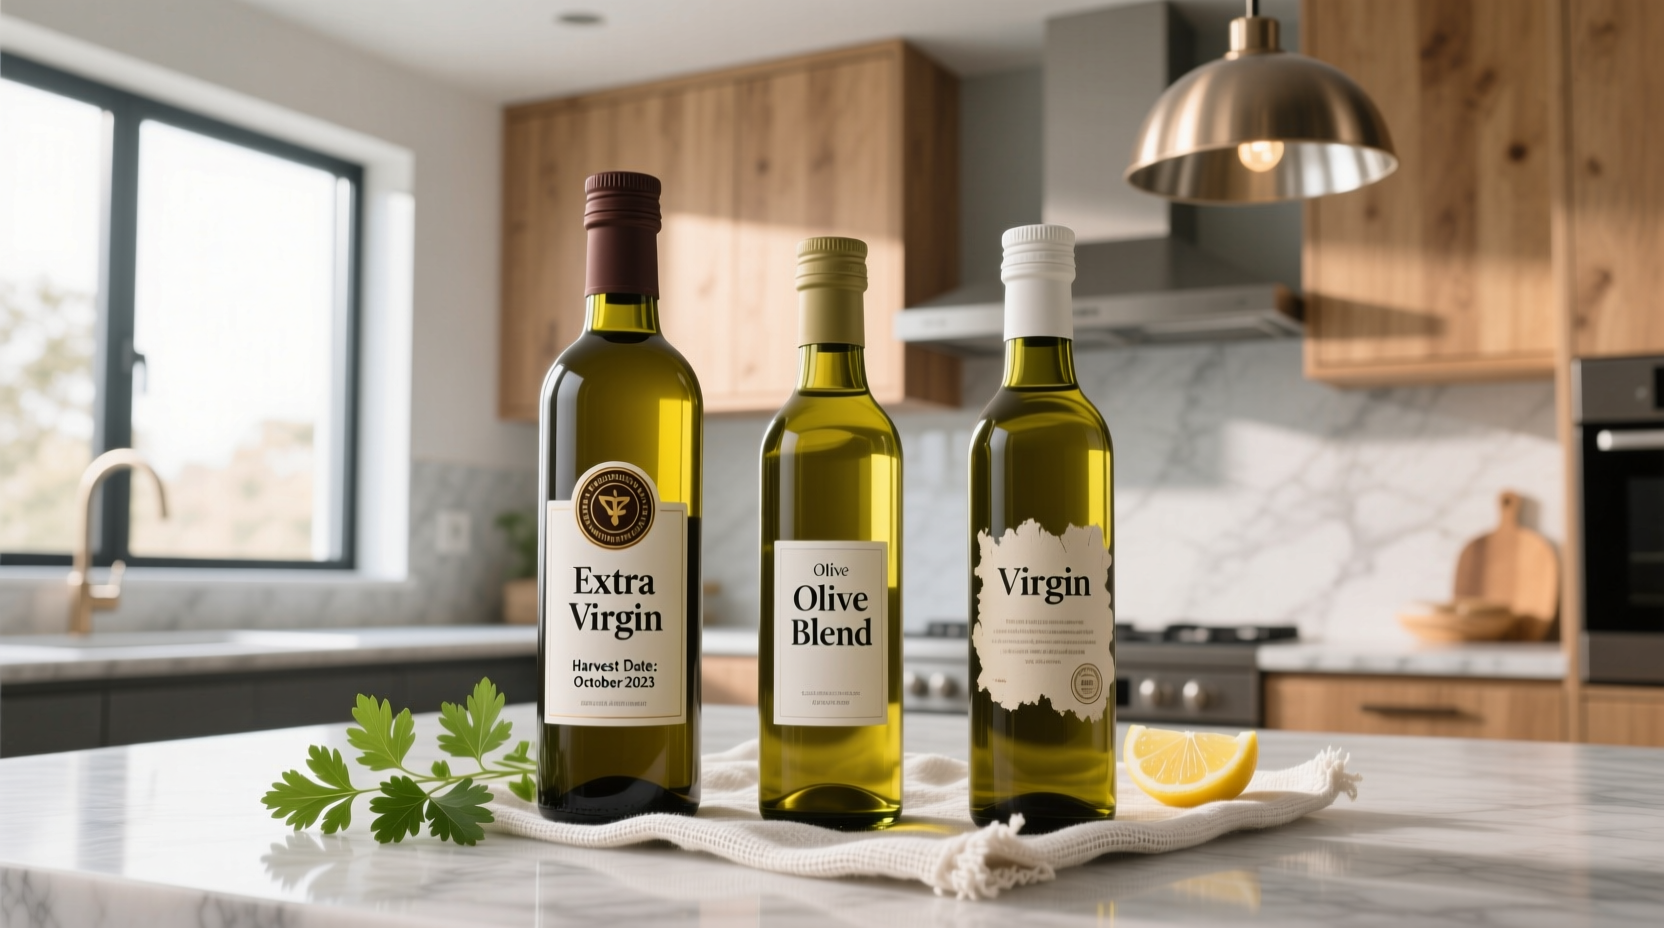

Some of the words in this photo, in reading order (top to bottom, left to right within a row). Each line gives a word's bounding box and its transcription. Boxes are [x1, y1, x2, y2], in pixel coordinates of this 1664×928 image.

[573, 566, 655, 595] Extra
[813, 562, 849, 577] Olive
[793, 584, 868, 612] Olive
[997, 566, 1091, 605] Virgin
[569, 602, 663, 640] Virgin
[791, 617, 872, 646] Blend
[572, 659, 619, 672] Harvest
[624, 659, 658, 672] Date:
[574, 676, 623, 688] October
[624, 676, 655, 688] 2023
